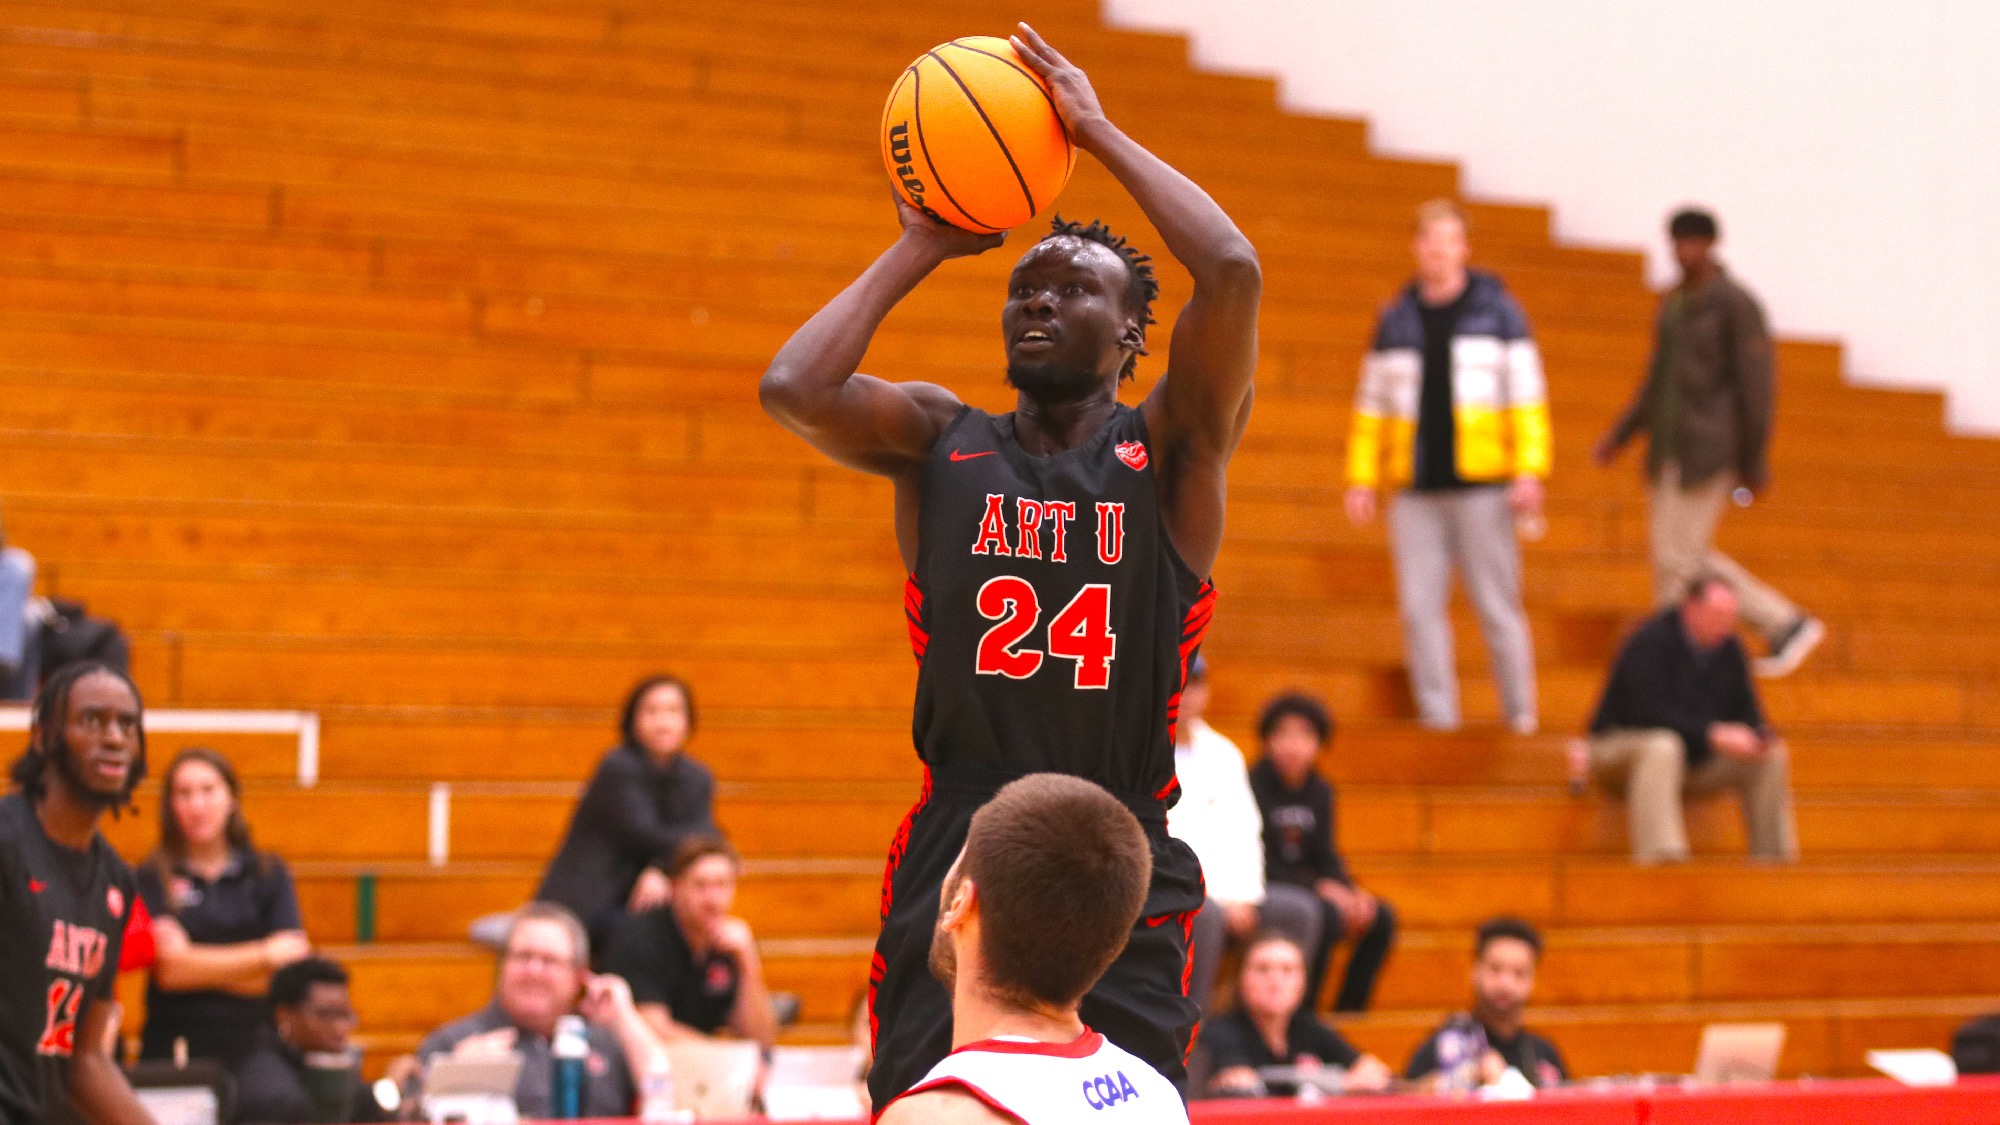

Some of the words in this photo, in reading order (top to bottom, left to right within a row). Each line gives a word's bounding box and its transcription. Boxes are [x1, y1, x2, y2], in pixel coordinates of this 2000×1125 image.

[972, 493, 1076, 563] ART
[1095, 502, 1125, 565] U
[976, 575, 1116, 690] 24
[1083, 1070, 1139, 1110] CCAA
